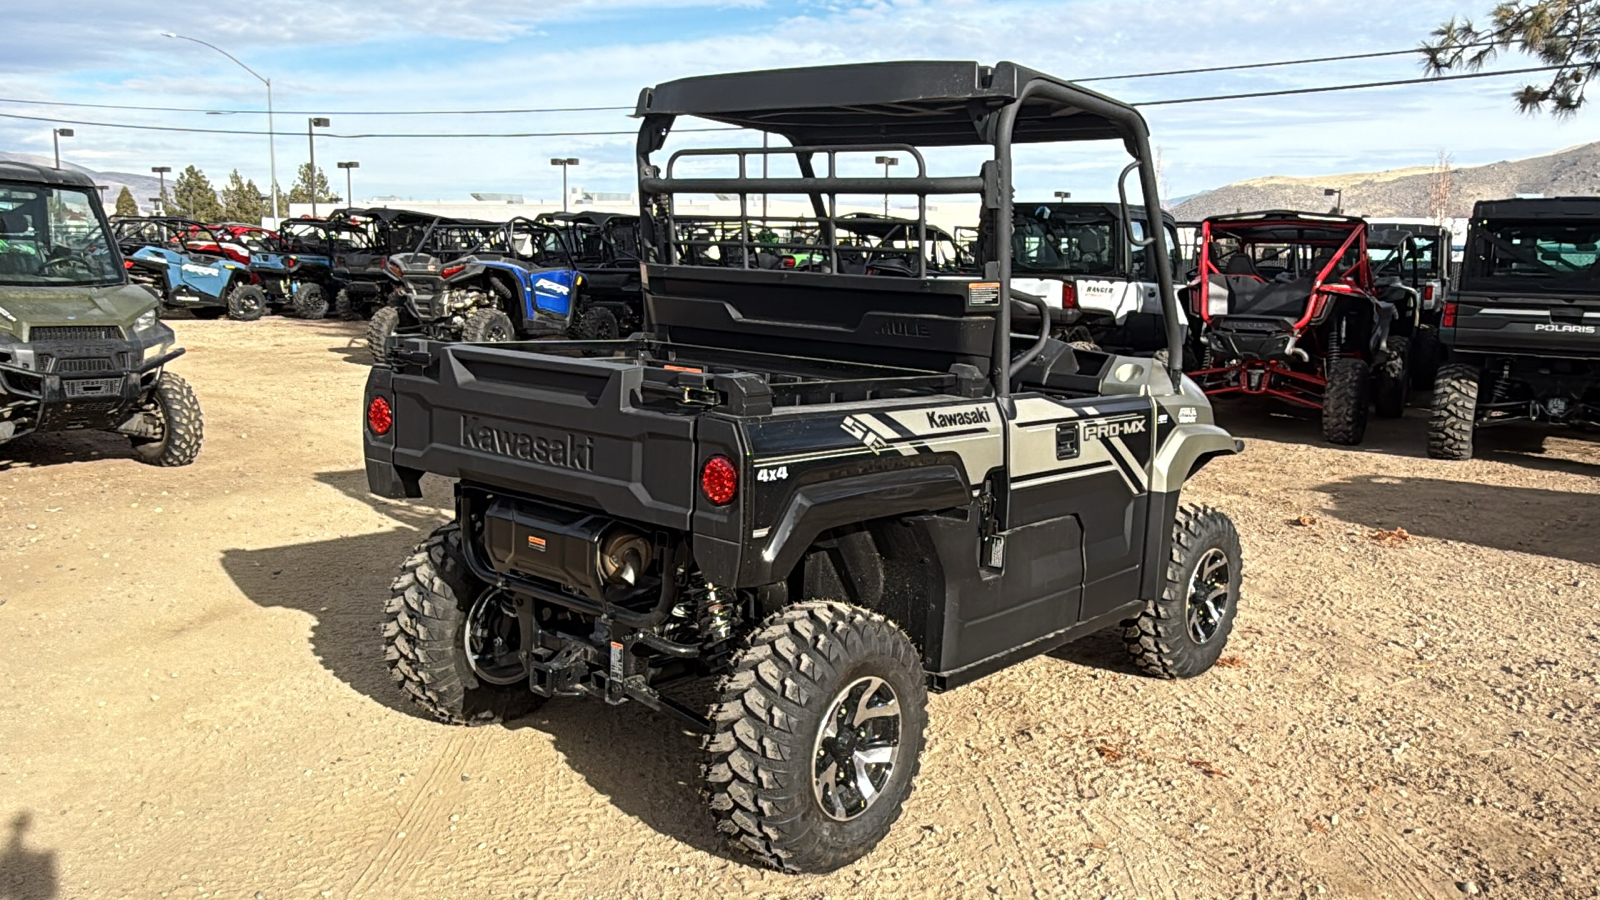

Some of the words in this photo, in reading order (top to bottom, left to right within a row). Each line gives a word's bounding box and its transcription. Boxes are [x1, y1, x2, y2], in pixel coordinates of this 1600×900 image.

[1534, 323, 1596, 334] POLARIS
[926, 407, 991, 429] Kawasaki
[1083, 419, 1147, 442] PRO-MX
[460, 414, 595, 472] Kawasaki
[757, 466, 789, 482] 4x4
